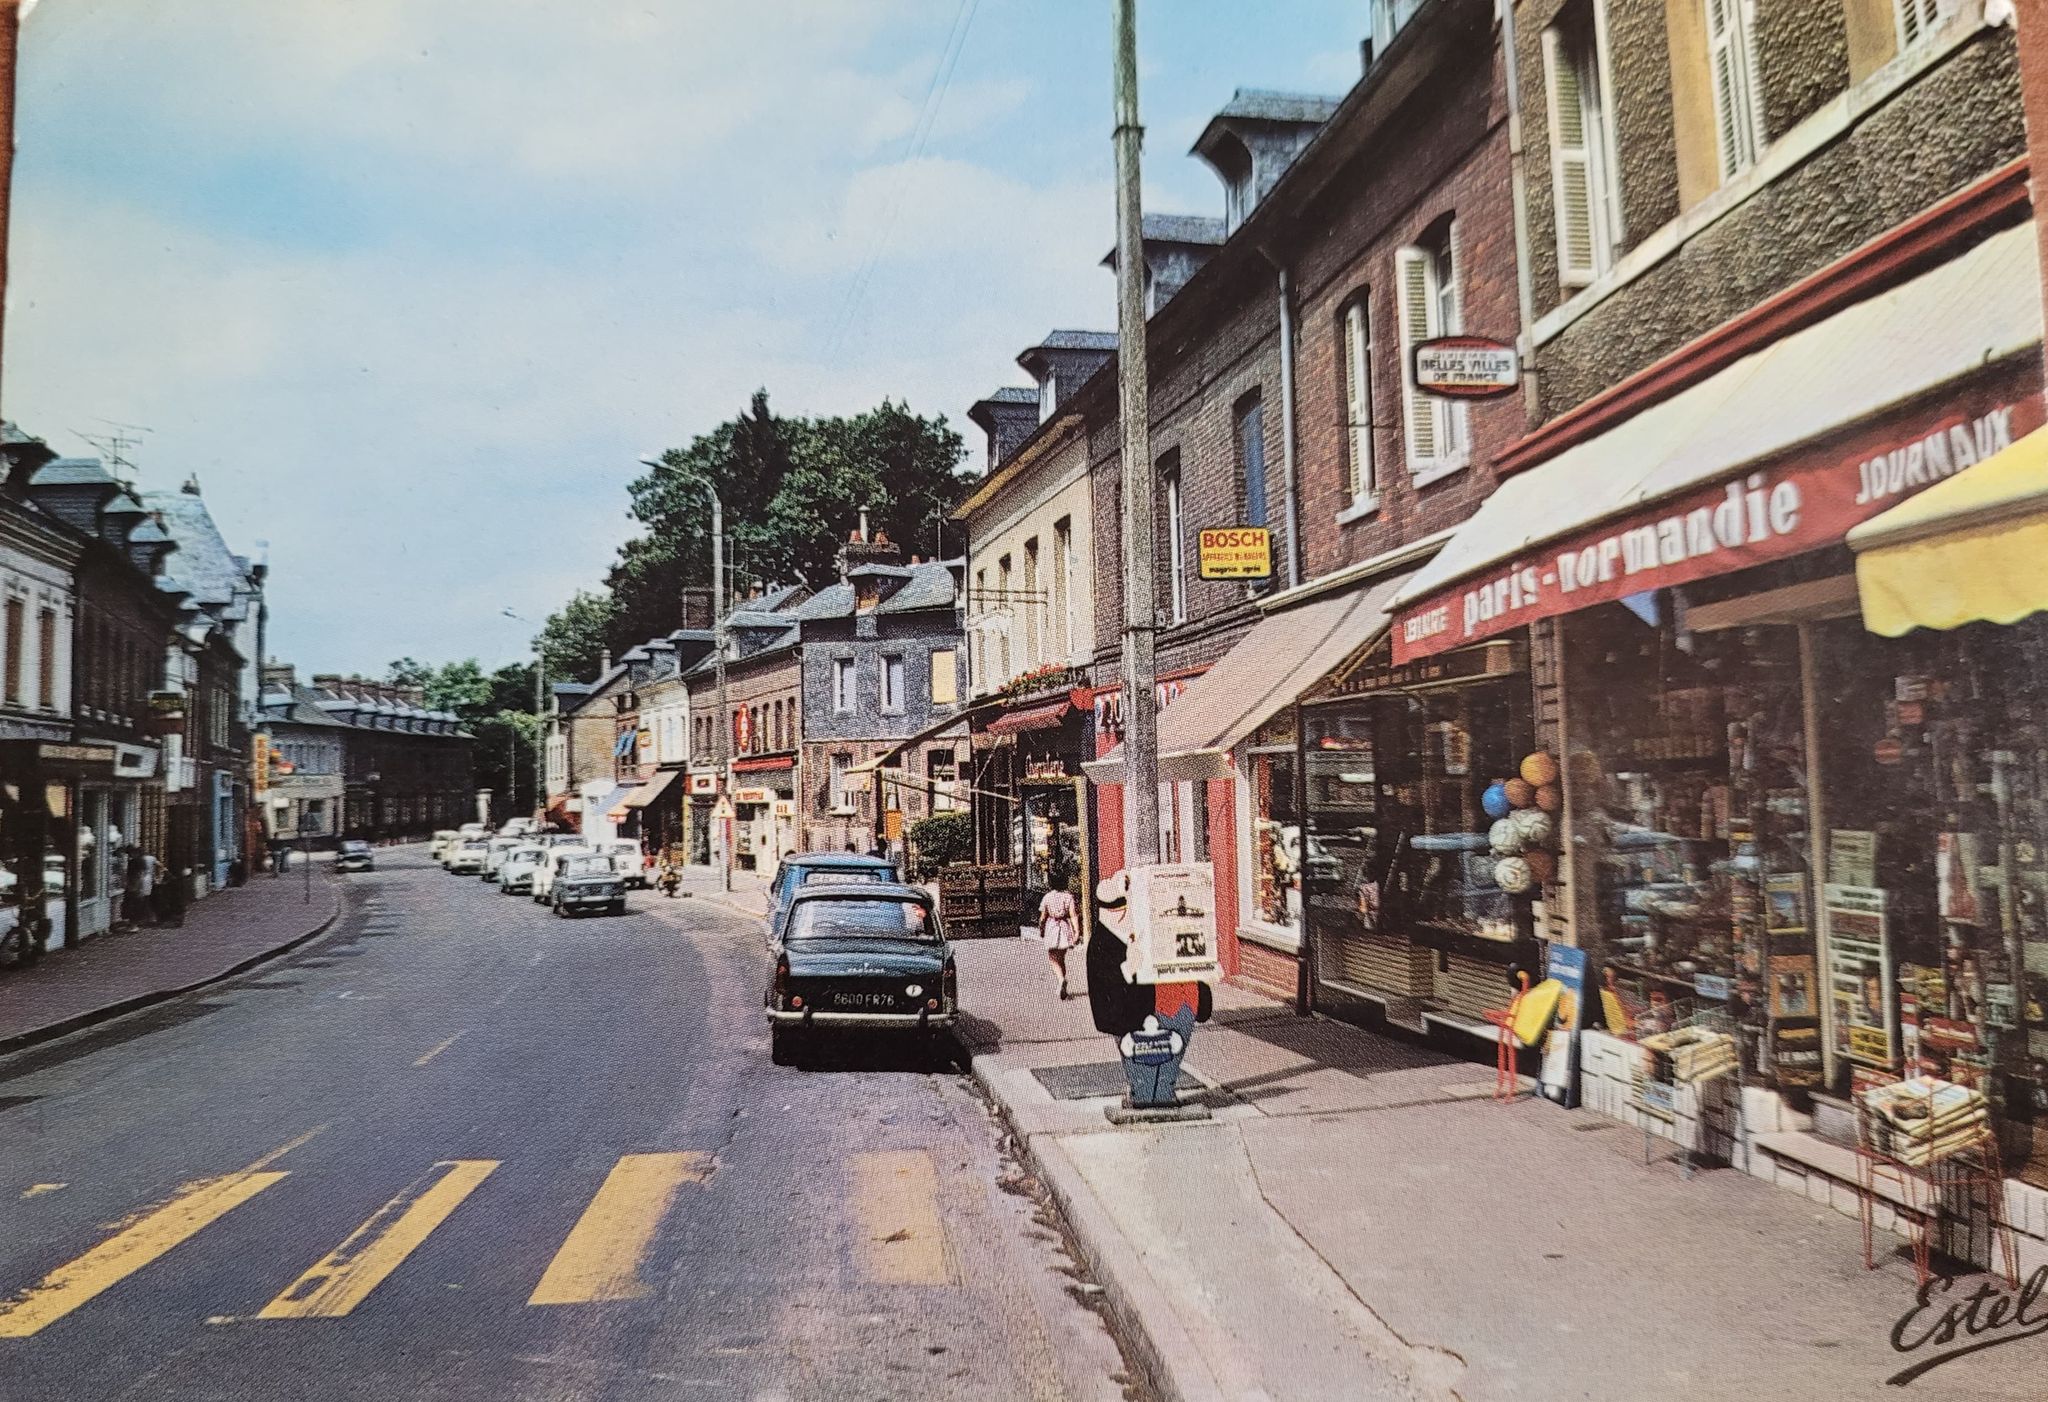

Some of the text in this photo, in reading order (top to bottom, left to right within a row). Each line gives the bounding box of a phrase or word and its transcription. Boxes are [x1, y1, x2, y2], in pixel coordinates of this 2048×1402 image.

[1421, 360, 1511, 372] BELLES VILLES
[1433, 373, 1498, 382] DE FRANCE
[1856, 405, 2014, 505] JOURNAUX
[1203, 531, 1265, 548] BOSCH
